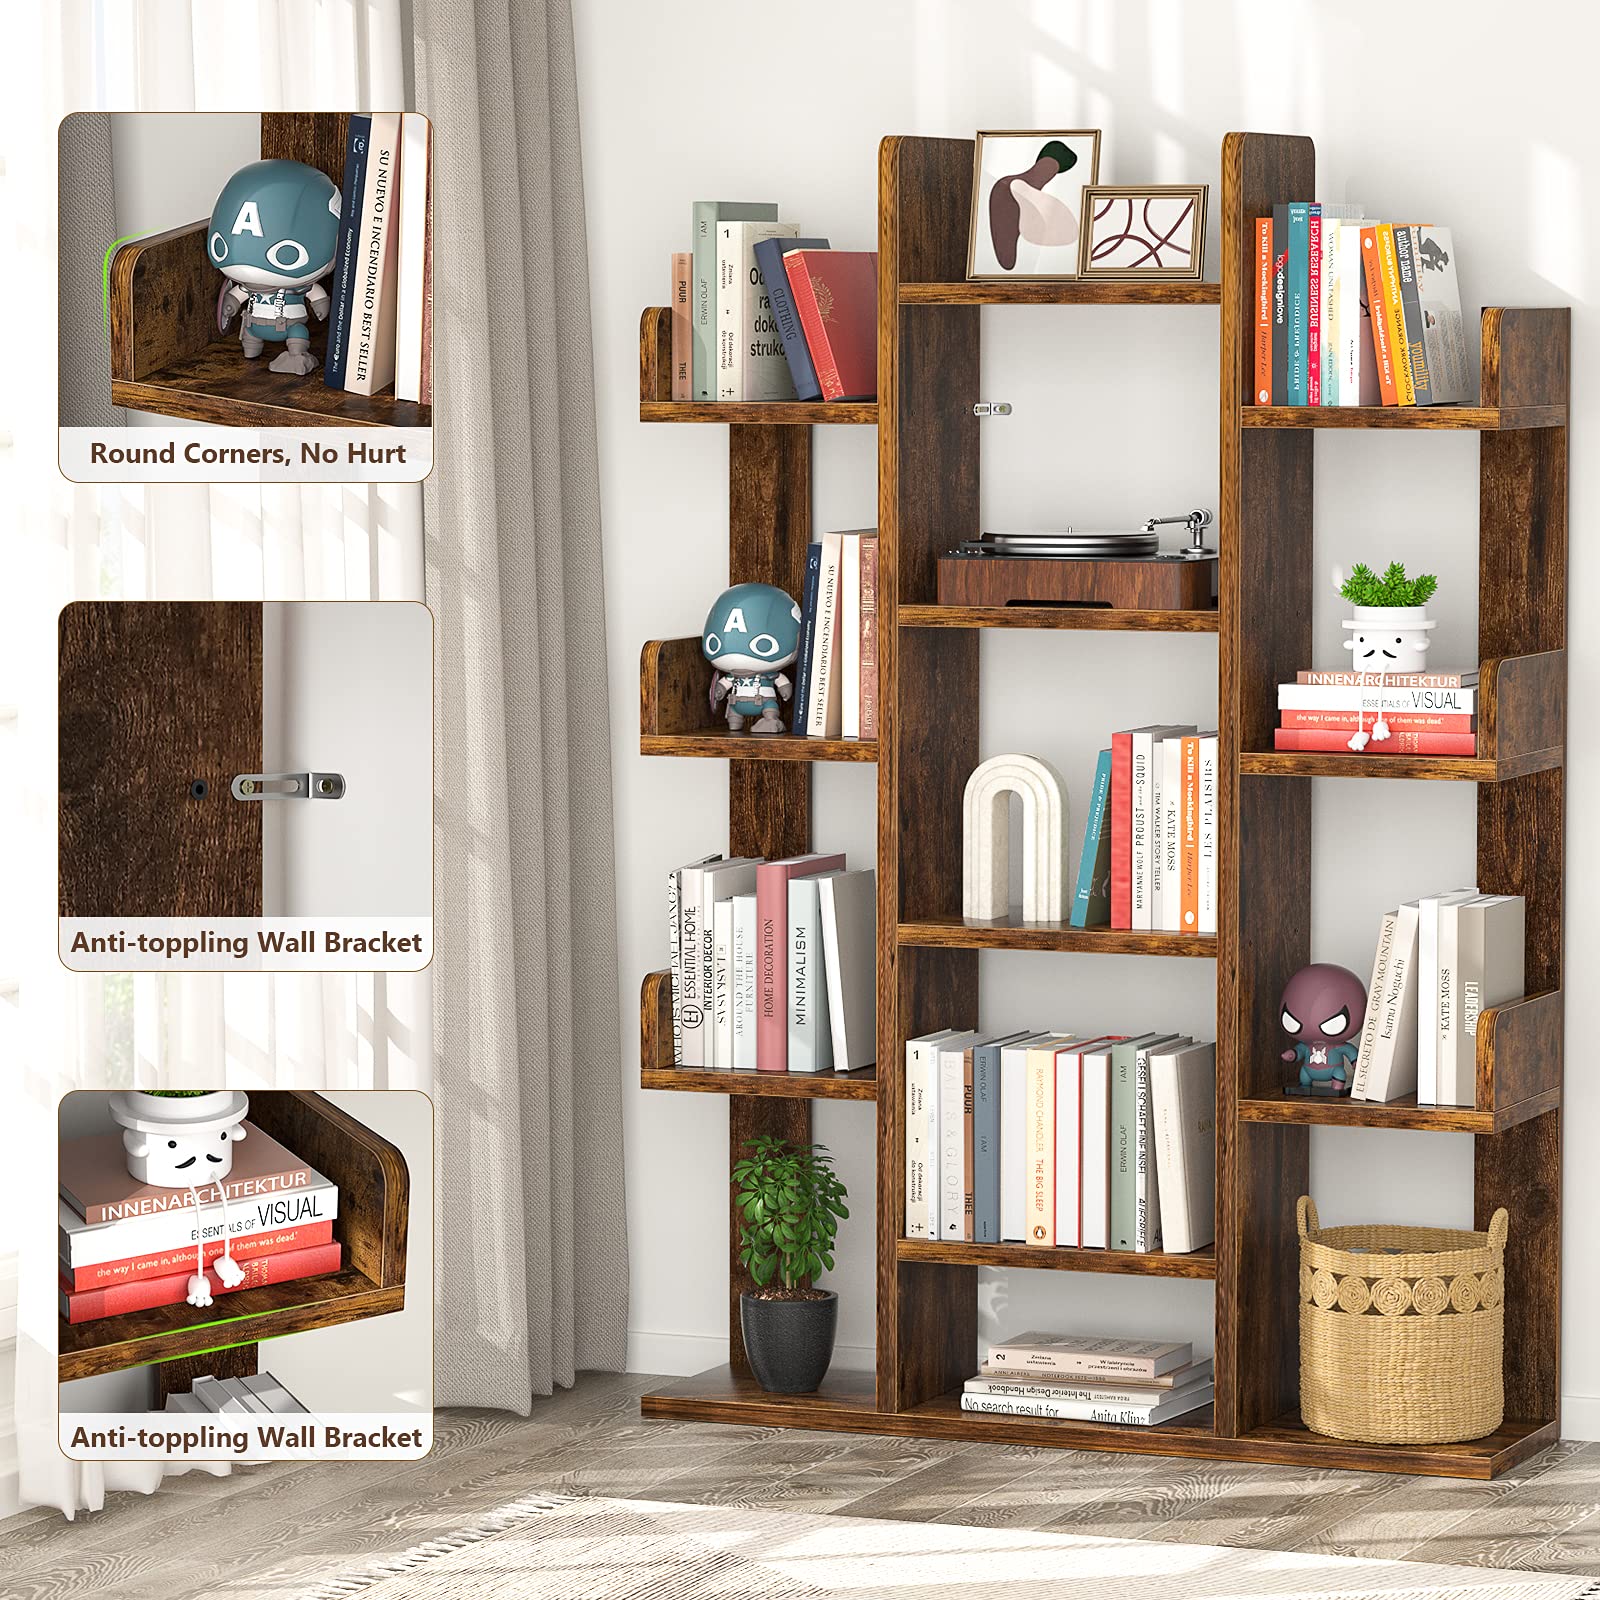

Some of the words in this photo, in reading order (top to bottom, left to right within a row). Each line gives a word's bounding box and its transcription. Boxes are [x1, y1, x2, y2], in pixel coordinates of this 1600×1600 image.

[379, 149, 390, 166] SU
[374, 168, 388, 213] NUEVO
[231, 201, 264, 237] A
[701, 221, 708, 234] AM
[724, 229, 730, 239] 1
[1261, 222, 1268, 234] To
[344, 228, 354, 257] Economy
[1261, 236, 1269, 254] Kill
[1397, 230, 1412, 259] author
[341, 257, 350, 289] Globalized
[364, 226, 381, 310] INCENDIARIO
[1401, 260, 1413, 283] name
[679, 280, 687, 303] PUUR
[1260, 261, 1269, 320] Mockingbird
[361, 312, 373, 340] BEST
[773, 288, 797, 341] CLOTHING
[356, 341, 370, 381] SELLER
[679, 362, 687, 380] THEE
[1409, 341, 1429, 391] youmility
[828, 565, 835, 576] SU
[825, 577, 834, 608] NUEVO
[724, 608, 747, 632] A
[820, 616, 831, 675] INCENDIARIO
[818, 677, 826, 697] BEST
[1307, 673, 1458, 688] INNENARCHITEKTUR
[815, 698, 824, 726] SELLER
[1412, 691, 1462, 709] VISUAL
[1397, 717, 1412, 725] them
[1187, 742, 1194, 755] To
[1136, 754, 1145, 785] SQUID
[1167, 810, 1176, 838] KATE
[1186, 782, 1194, 841] Mockingbird
[1136, 808, 1144, 846] PROUST
[1167, 841, 1176, 871] MOSS
[684, 906, 696, 941] HOME
[704, 929, 712, 962] DECOR
[735, 927, 744, 962] HOUSE
[764, 919, 773, 984] DECORATION
[1377, 920, 1394, 981] MOUNTAIN
[684, 945, 696, 999] ESSENTIAL
[735, 967, 744, 987] THE
[745, 952, 753, 1013] FURNITURE
[796, 927, 806, 1025] MINIMALISM
[1387, 958, 1405, 1005] Noguchi
[1441, 968, 1450, 999] MOSS
[704, 965, 712, 1010] INTERIOR
[764, 988, 773, 1017] HOME
[1371, 982, 1384, 1012] GRAY
[735, 992, 744, 1036] AROUND
[1367, 1017, 1377, 1031] DE
[1380, 1008, 1396, 1039] Isamu
[1441, 1001, 1450, 1031] KATE
[1358, 1033, 1374, 1080] SECRETO
[964, 1085, 972, 1114] PUUR
[1035, 1068, 1043, 1108] RAYMOND
[1356, 1082, 1365, 1092] EL
[1035, 1111, 1043, 1152] CHANDLER
[1035, 1159, 1043, 1174] THE
[101, 1171, 307, 1222] INNENARCHITEKTUR
[1035, 1176, 1043, 1189] BIG
[244, 1219, 256, 1231] OF
[257, 1195, 323, 1228] VISUAL
[964, 1192, 972, 1215] THEE
[1035, 1191, 1043, 1212] SLEEP
[97, 1268, 111, 1278] the
[113, 1265, 129, 1278] way
[136, 1260, 159, 1272] came
[160, 1257, 171, 1267] in,
[208, 1247, 224, 1257] one
[236, 1241, 257, 1252] them
[259, 1238, 274, 1247] was
[988, 1384, 1024, 1395] Handbook
[1027, 1386, 1050, 1397] Design
[1052, 1387, 1077, 1399] Interior
[1078, 1389, 1091, 1400] The
[965, 1398, 978, 1411] No
[981, 1400, 1013, 1412] search
[1016, 1402, 1043, 1415] result
[1046, 1404, 1059, 1417] for
